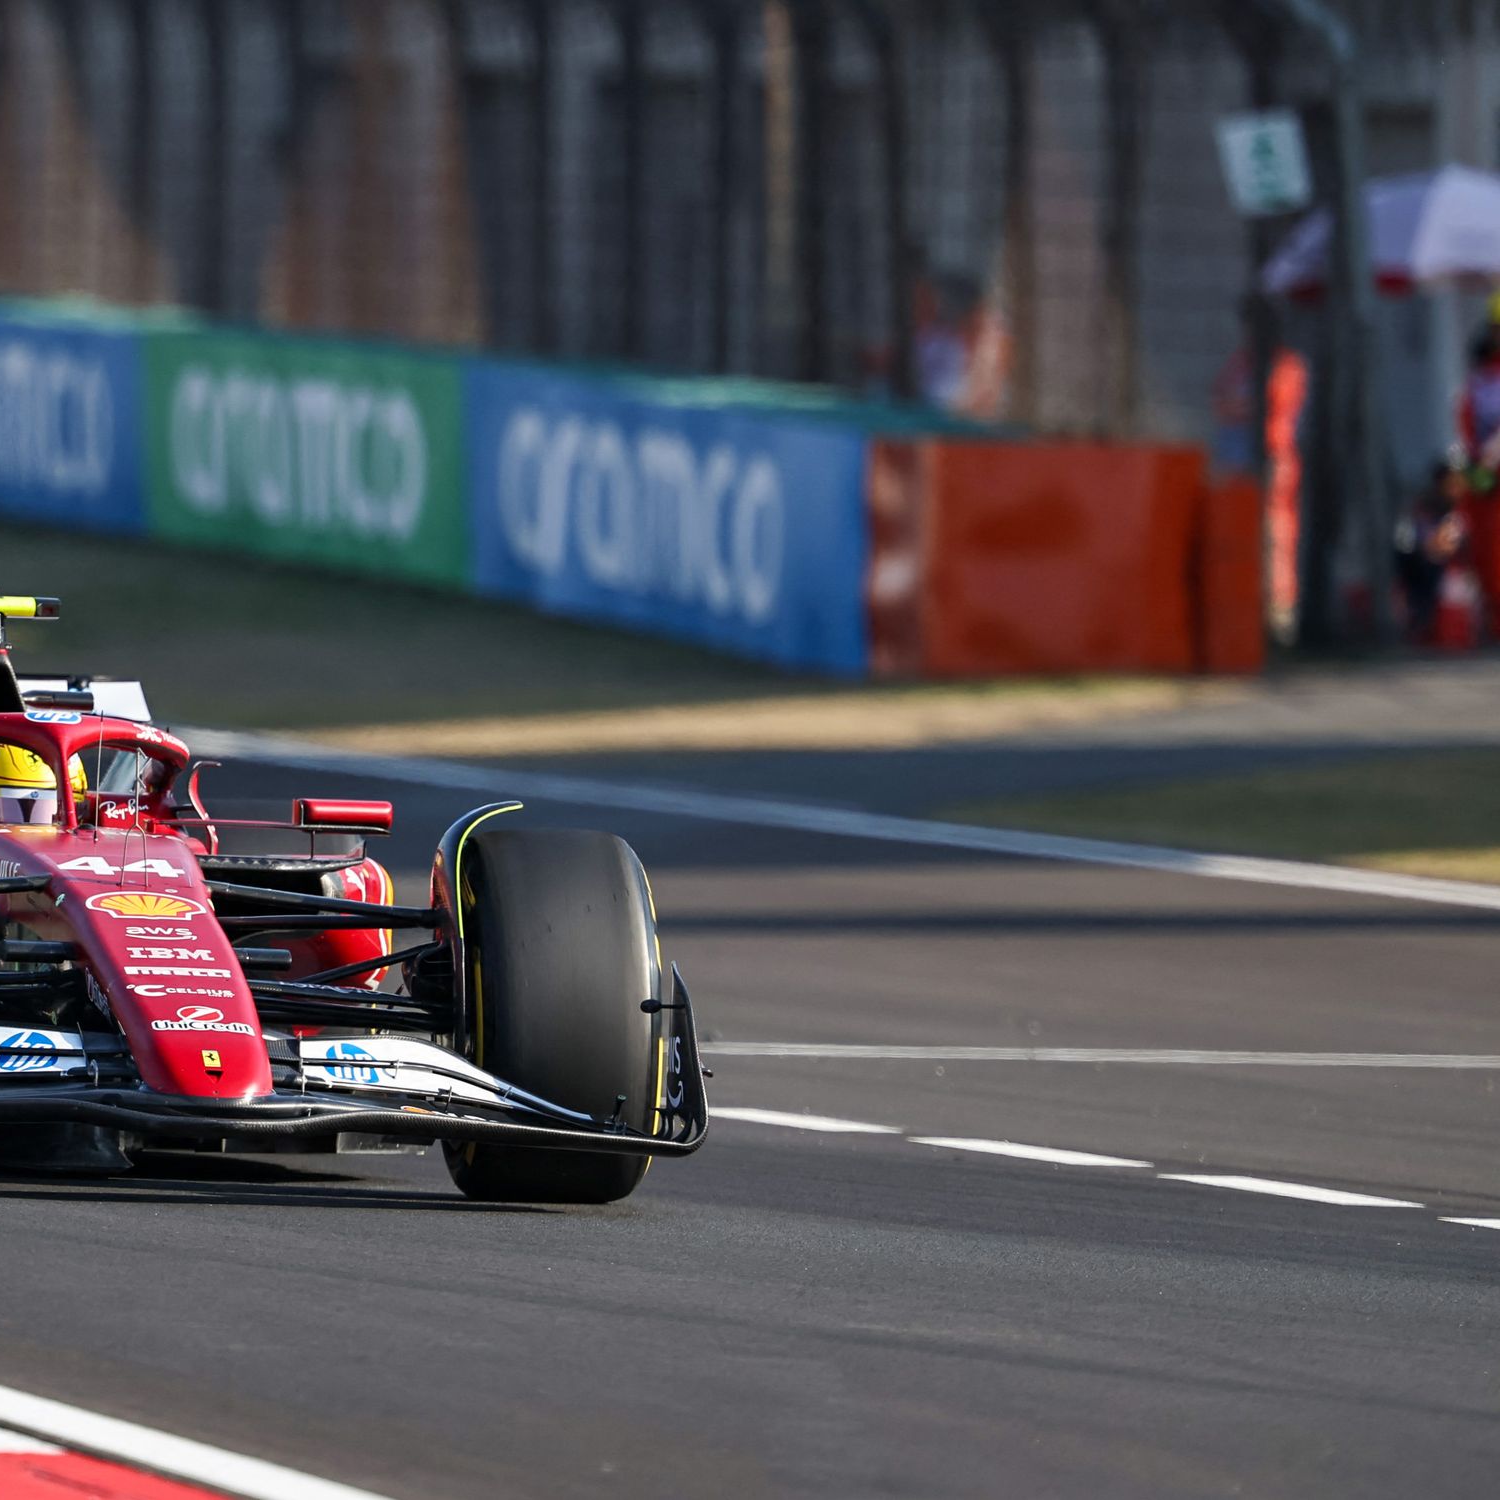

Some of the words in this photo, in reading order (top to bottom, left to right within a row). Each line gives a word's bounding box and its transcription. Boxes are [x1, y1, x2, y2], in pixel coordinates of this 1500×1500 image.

[500, 410, 784, 622] aramco
[57, 856, 185, 877] 44
[125, 926, 194, 937] aws
[126, 947, 215, 961] IBM
[152, 1020, 255, 1035] UniCredit
